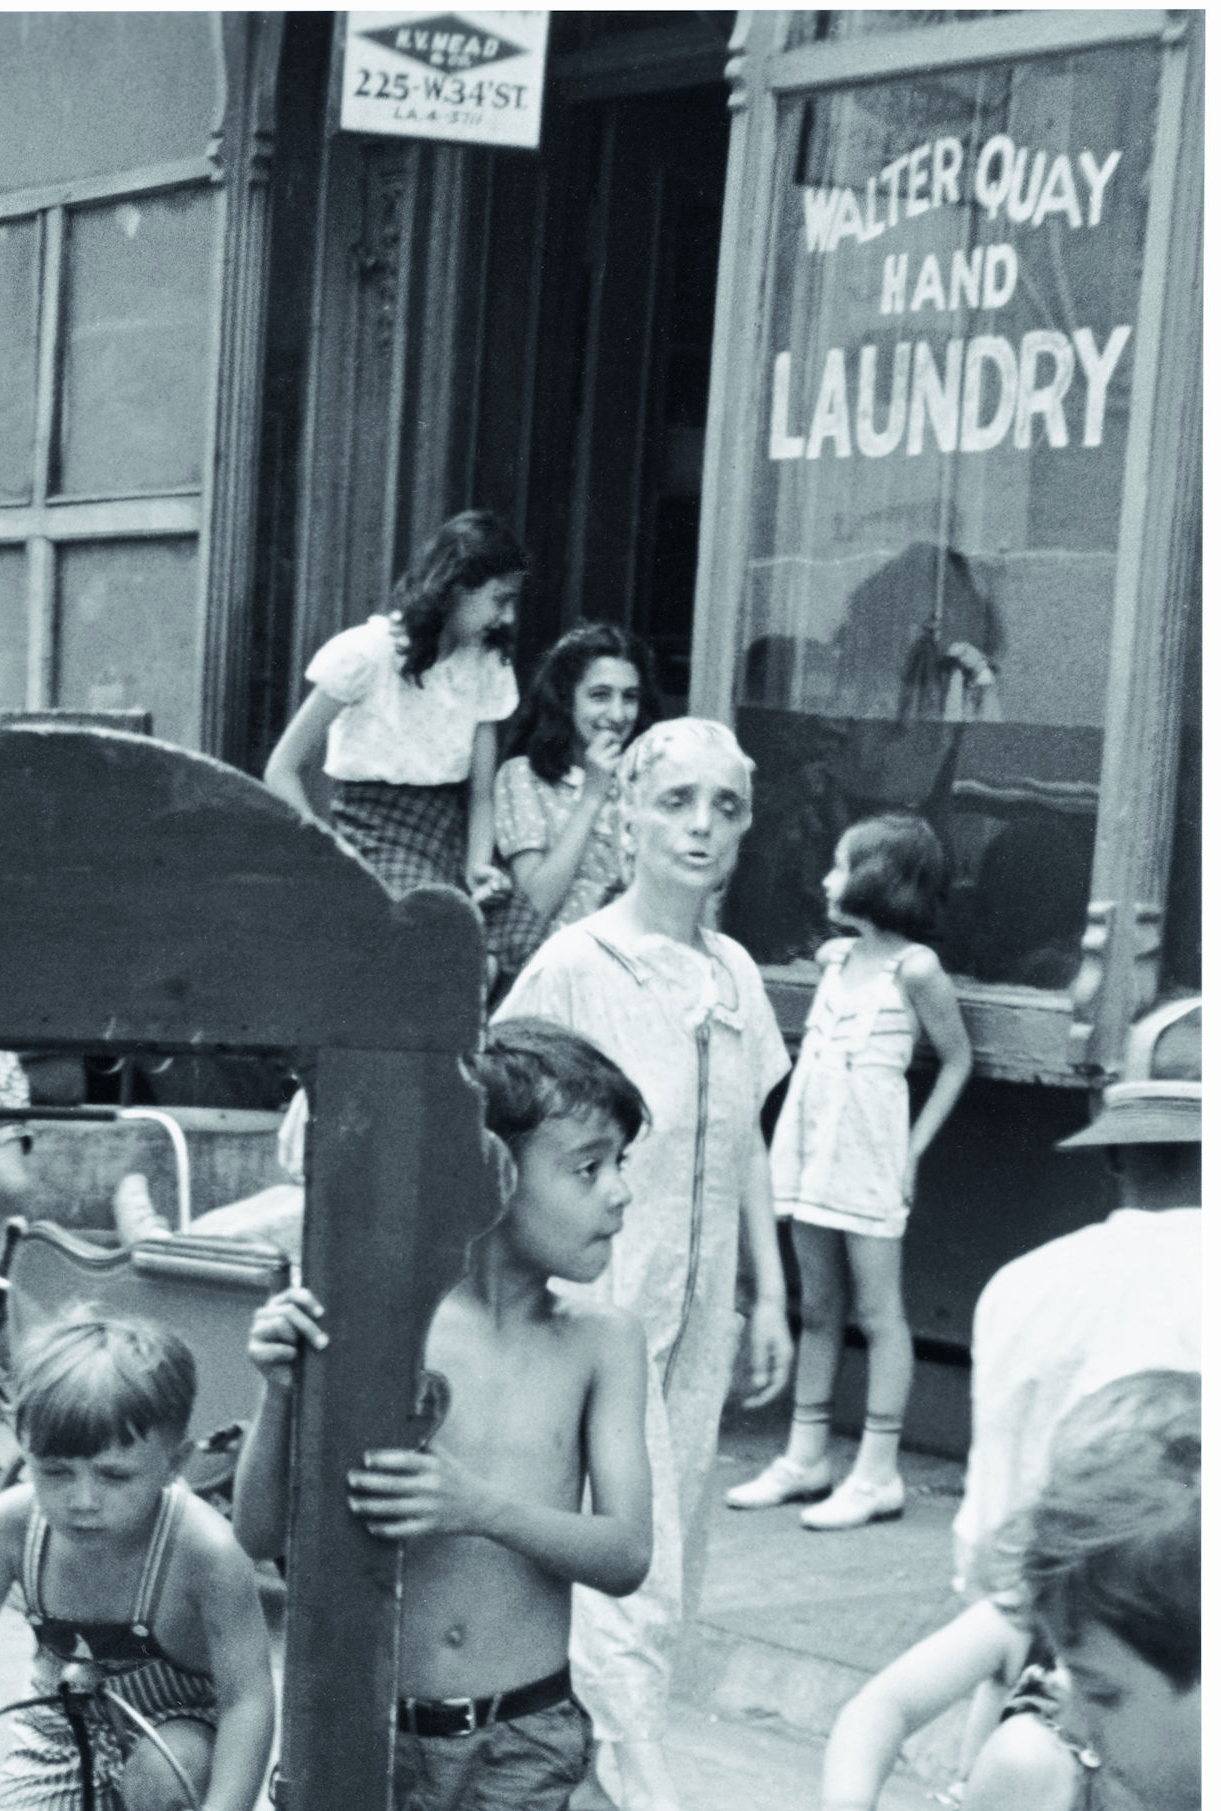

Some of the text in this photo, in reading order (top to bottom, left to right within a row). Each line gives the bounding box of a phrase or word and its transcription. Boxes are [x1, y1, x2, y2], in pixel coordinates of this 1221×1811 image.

[804, 133, 1123, 252] WALTER QUAY
[880, 243, 1019, 315] HAND
[768, 324, 1134, 461] LAUNDRY
